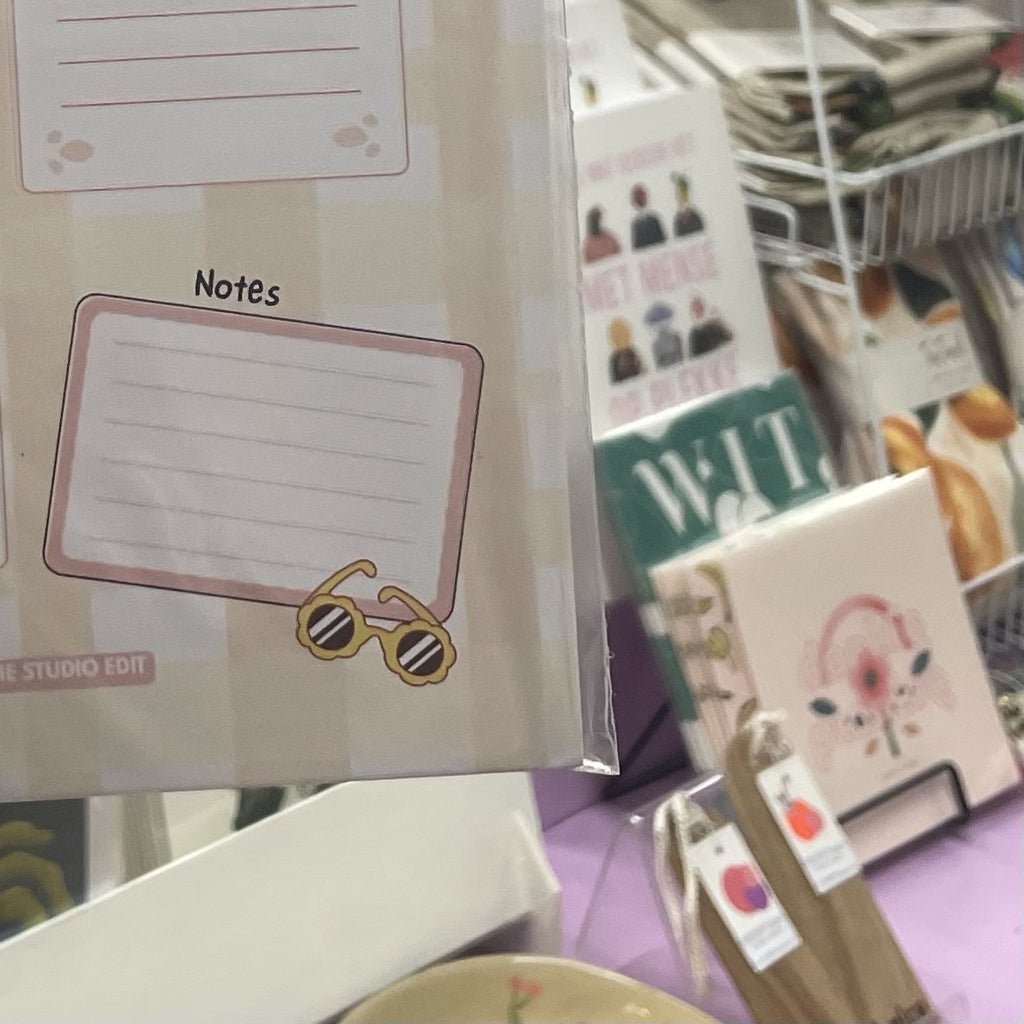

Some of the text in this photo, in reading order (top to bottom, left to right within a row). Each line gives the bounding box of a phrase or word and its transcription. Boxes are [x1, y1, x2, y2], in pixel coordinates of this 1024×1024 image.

[195, 268, 281, 307] Notes
[22, 657, 99, 681] STUDIO
[104, 654, 147, 676] EDIT
